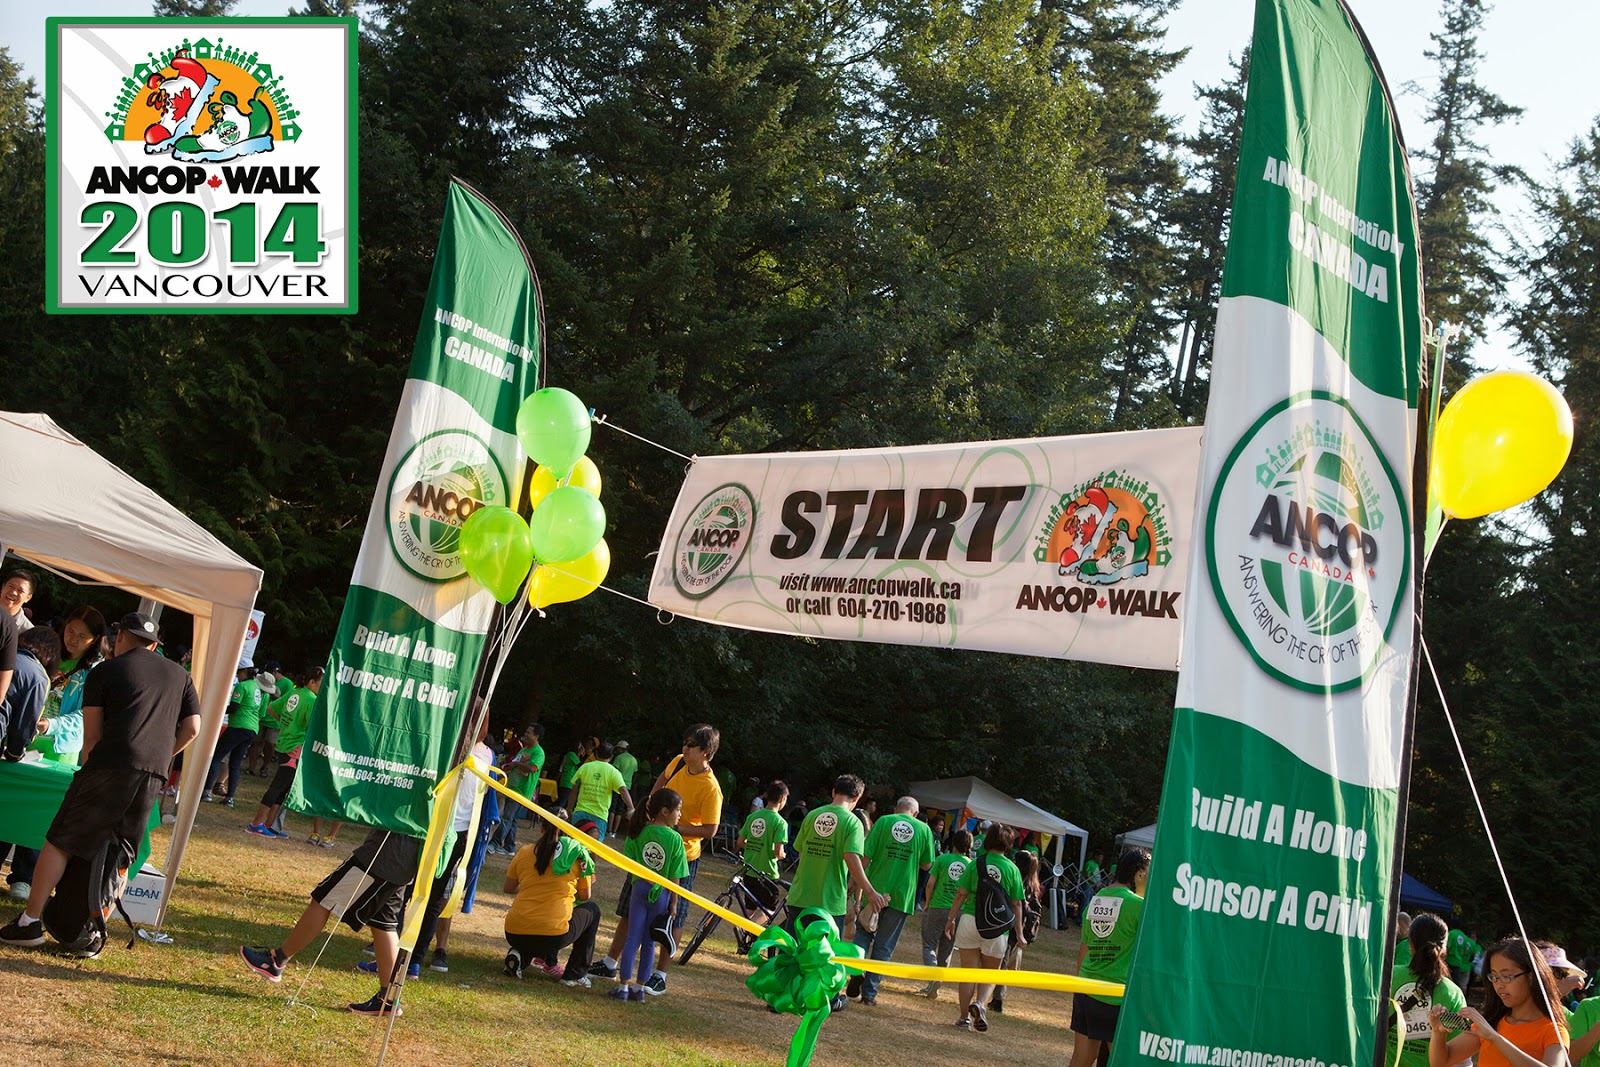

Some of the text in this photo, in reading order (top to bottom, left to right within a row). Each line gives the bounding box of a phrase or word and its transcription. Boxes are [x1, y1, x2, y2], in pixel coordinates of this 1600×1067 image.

[1262, 155, 1318, 206] ANCOP
[1288, 211, 1389, 304] CANADA
[434, 307, 473, 334] ANCOP
[444, 336, 515, 384] CANADA
[423, 509, 463, 528] CANADA
[769, 484, 1027, 563] START
[1250, 493, 1378, 570] ANCOP
[687, 528, 740, 549] ANCOP
[444, 557, 454, 569] OF
[1288, 552, 1354, 584] CANADA
[779, 572, 962, 600] visit www.ancopwalk.ca
[1014, 584, 1182, 620] ANCOP WALK
[786, 597, 947, 625] or call 604-270-1988
[1238, 554, 1289, 644] ANSWERING
[1286, 634, 1308, 660] THE
[1331, 643, 1346, 664] OF
[352, 624, 457, 670] Build A Home
[401, 678, 416, 701] A
[416, 681, 459, 710] Child
[338, 767, 357, 780] call
[355, 768, 414, 790] 604-270-1988
[1263, 803, 1285, 846] A
[1289, 808, 1368, 862] Home
[123, 885, 160, 900] ILDAN
[1172, 862, 1373, 940] Sponsor A Child
[1093, 906, 1114, 916] 0331
[1138, 1030, 1185, 1064] VISIT
